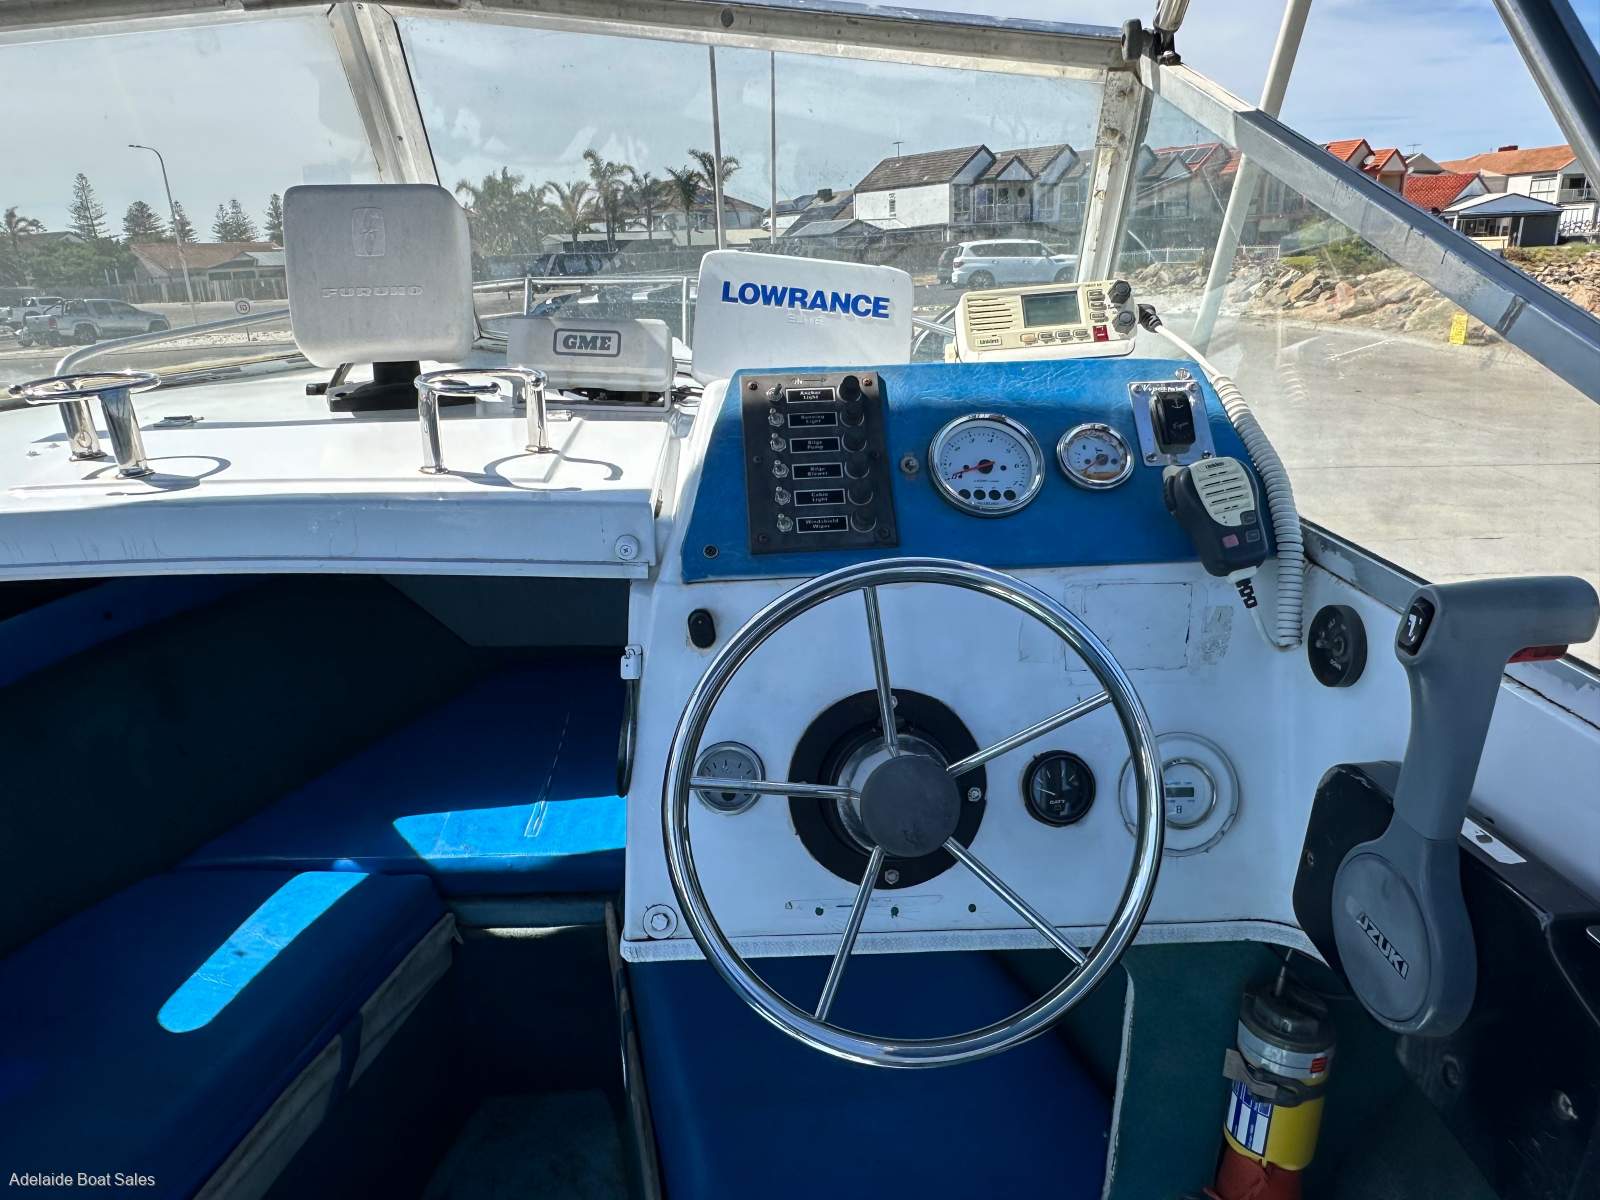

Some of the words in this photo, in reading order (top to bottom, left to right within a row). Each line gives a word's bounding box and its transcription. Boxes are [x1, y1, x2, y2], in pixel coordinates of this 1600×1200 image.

[321, 285, 425, 298] FURUNO
[721, 280, 890, 319] LOWRANCE
[562, 334, 612, 351] GME
